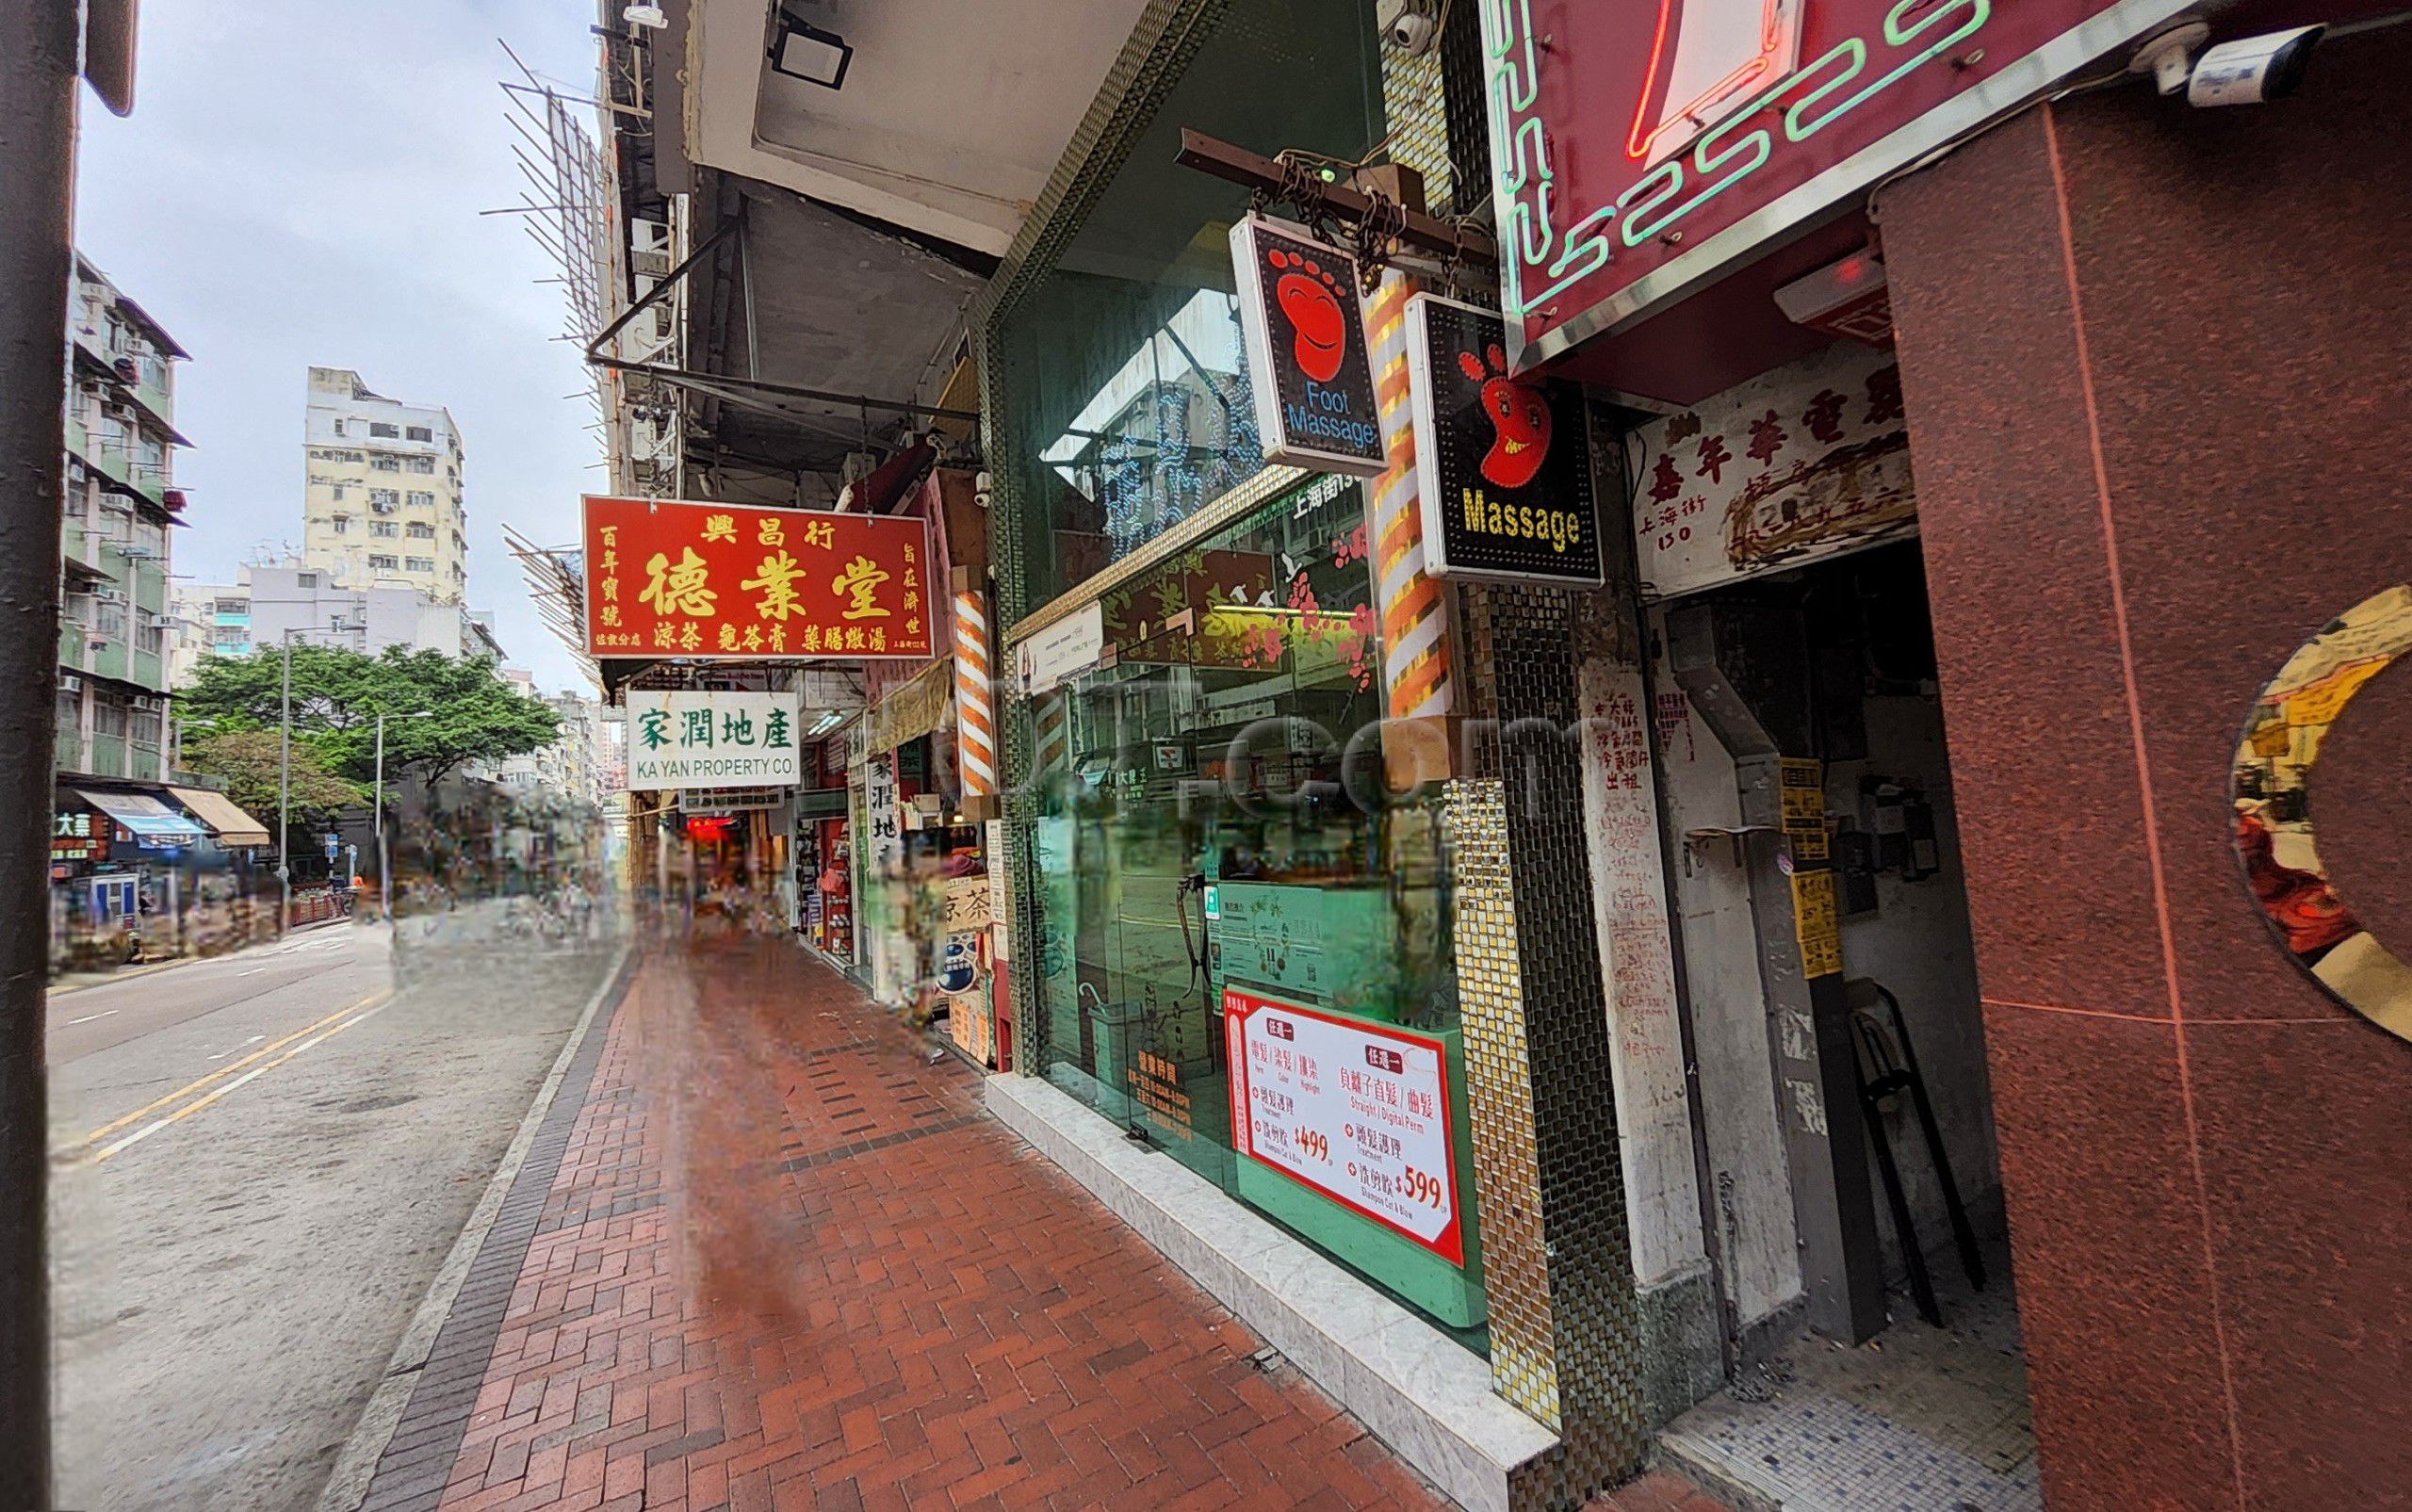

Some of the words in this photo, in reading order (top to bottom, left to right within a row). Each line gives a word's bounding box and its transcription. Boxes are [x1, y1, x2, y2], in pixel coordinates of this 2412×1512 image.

[1307, 381, 1351, 415] Foot
[1287, 403, 1375, 449] Massage
[700, 514, 838, 550] 興昌行
[1462, 487, 1580, 553] Massage
[1639, 493, 1707, 536] 上海街
[1658, 526, 1691, 551] 150
[598, 526, 624, 628] 百年寶號
[639, 546, 891, 622] 德業堂
[902, 543, 921, 635] 旨在濟世
[654, 622, 704, 652] 涼茶
[717, 623, 788, 653] 龜苓膏
[638, 707, 793, 752] 家潤地產
[637, 760, 659, 779] KA
[660, 759, 690, 777] YAN
[693, 758, 770, 777] PROPERTY
[1606, 772, 1642, 790] 出租
[1368, 1048, 1400, 1070] 任選一
[1350, 1096, 1377, 1121] Straight
[1381, 1106, 1405, 1129] Digital
[1405, 1115, 1425, 1134] Perm
[1295, 1124, 1329, 1162] $499
[1355, 1122, 1403, 1162] 頭髮護理
[1395, 1164, 1442, 1210] $599
